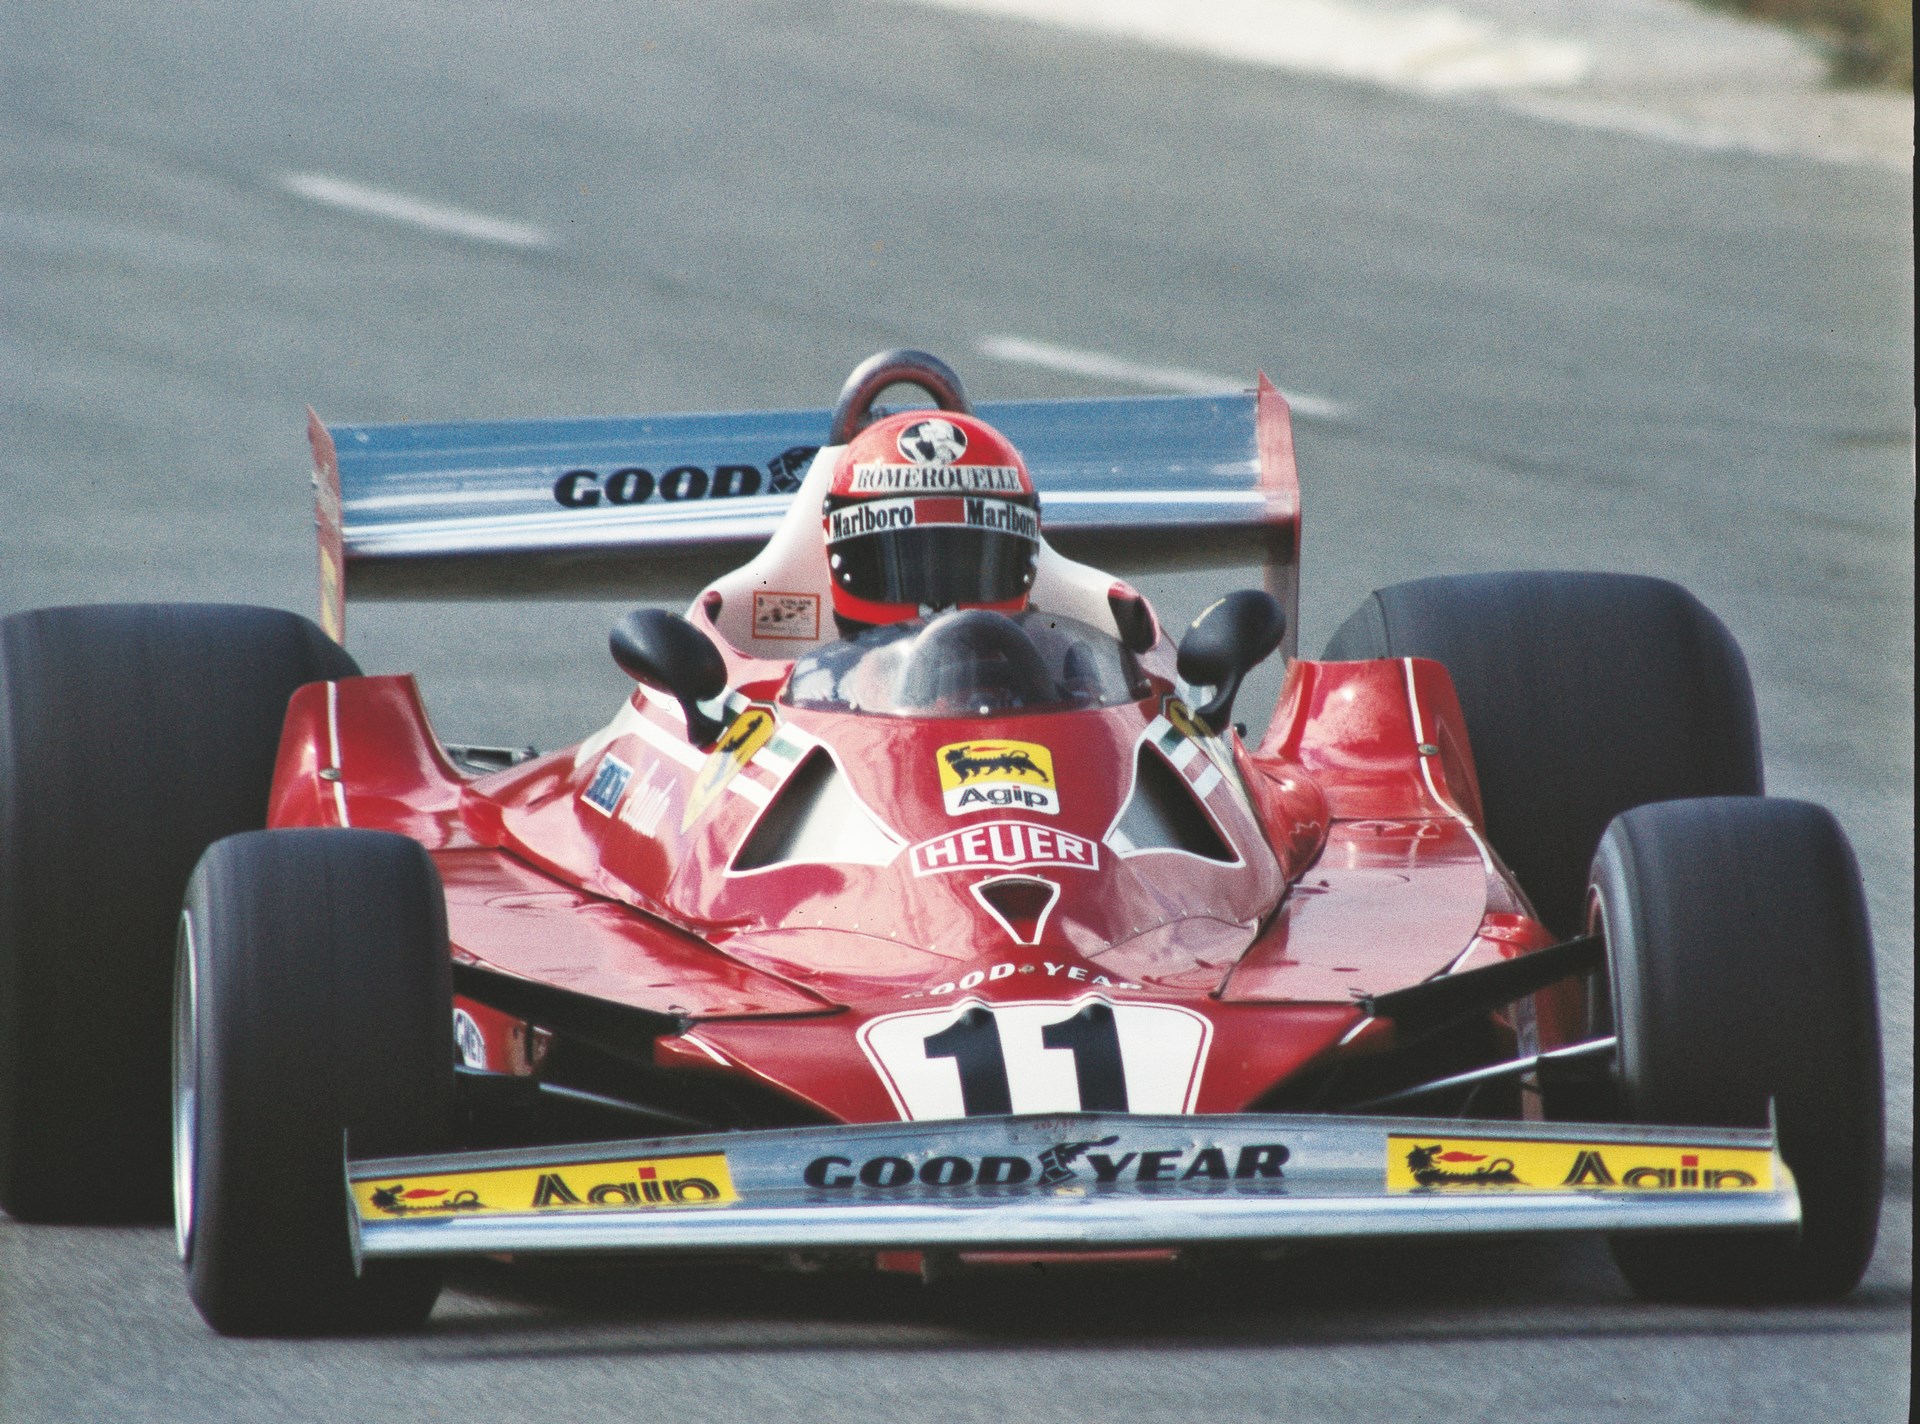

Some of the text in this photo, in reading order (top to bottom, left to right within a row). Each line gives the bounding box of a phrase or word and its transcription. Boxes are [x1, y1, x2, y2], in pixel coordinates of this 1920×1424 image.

[553, 464, 762, 508] GOOD
[832, 505, 914, 539] Marlboro
[966, 499, 1036, 538] Marlboro
[957, 785, 1049, 808] Agip
[925, 826, 1086, 867] HEUER
[922, 1003, 1129, 1117] 11
[803, 1144, 1290, 1188] GOOD YEAR
